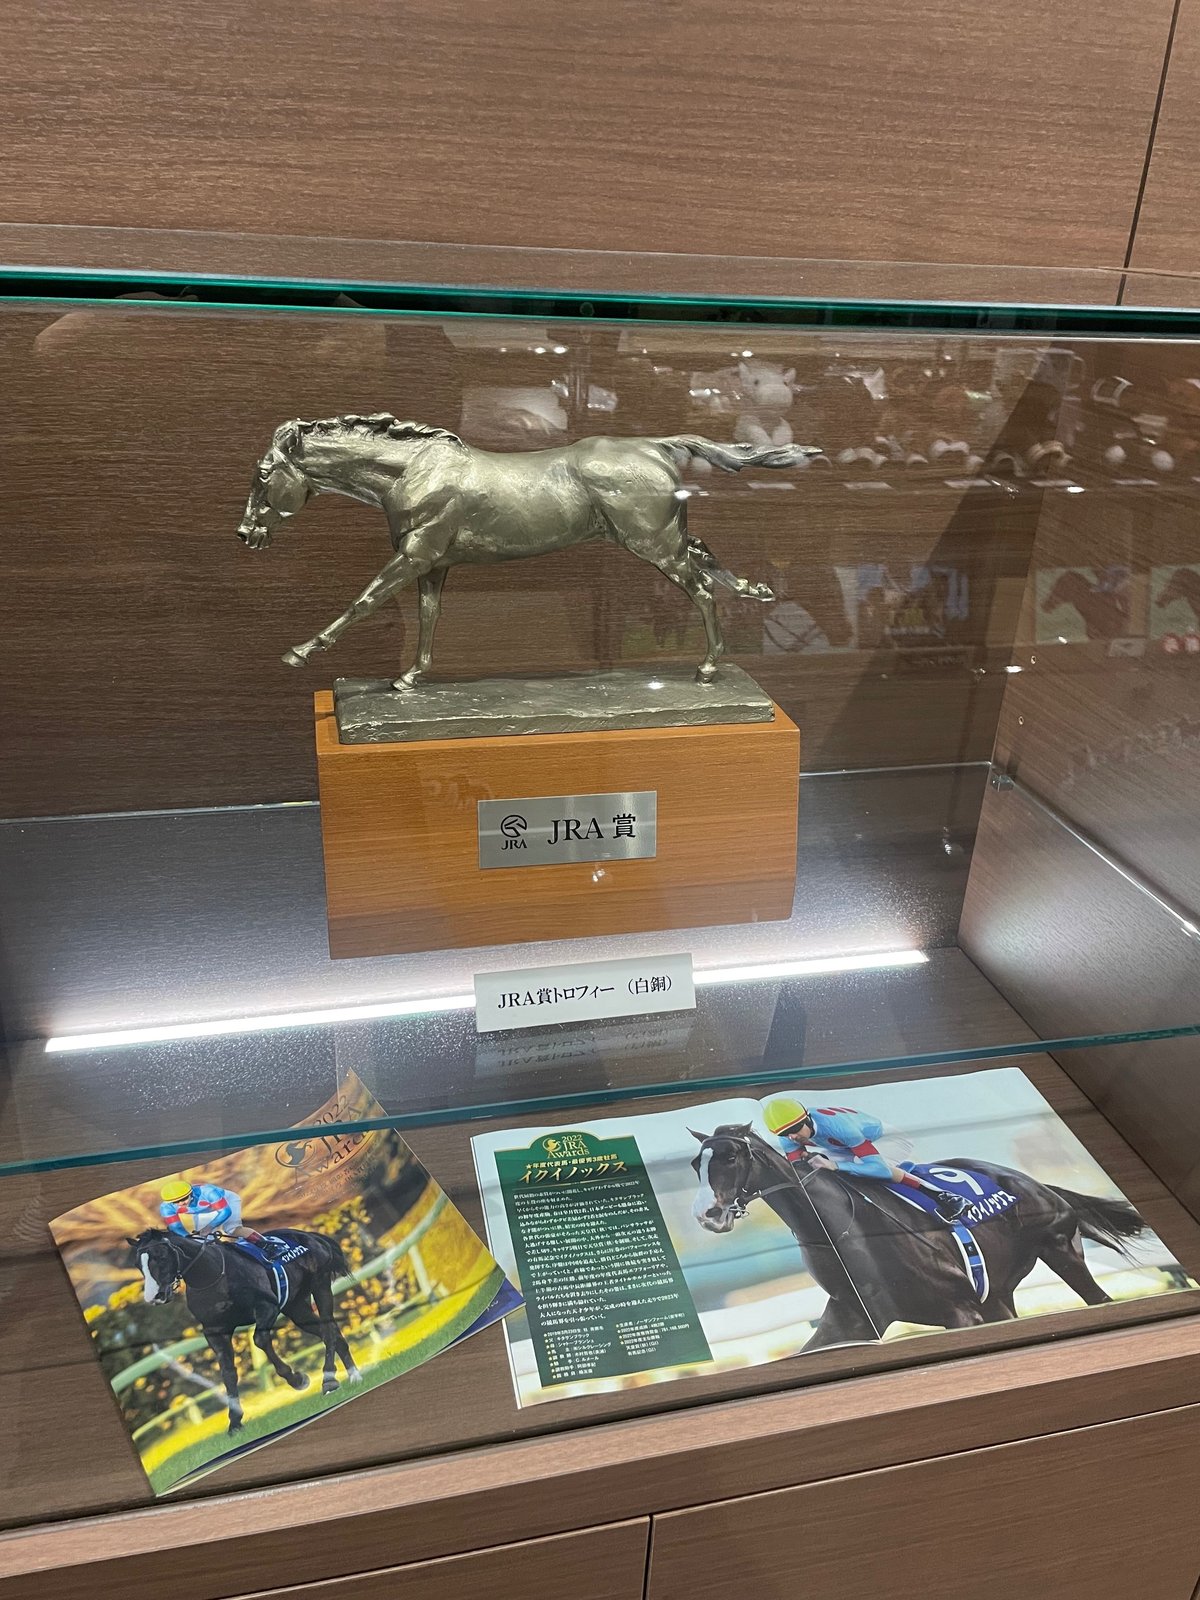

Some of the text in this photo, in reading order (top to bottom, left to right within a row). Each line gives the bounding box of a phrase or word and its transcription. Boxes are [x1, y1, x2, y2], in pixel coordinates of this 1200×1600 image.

[501, 839, 527, 850] JRA
[497, 984, 615, 1009] JRA賞トロフィー
[562, 1134, 583, 1142] 2022
[562, 1140, 588, 1151] JRA
[547, 1147, 590, 1159] Awards
[520, 1161, 628, 1184] イクイノックス
[929, 1167, 984, 1196] 9
